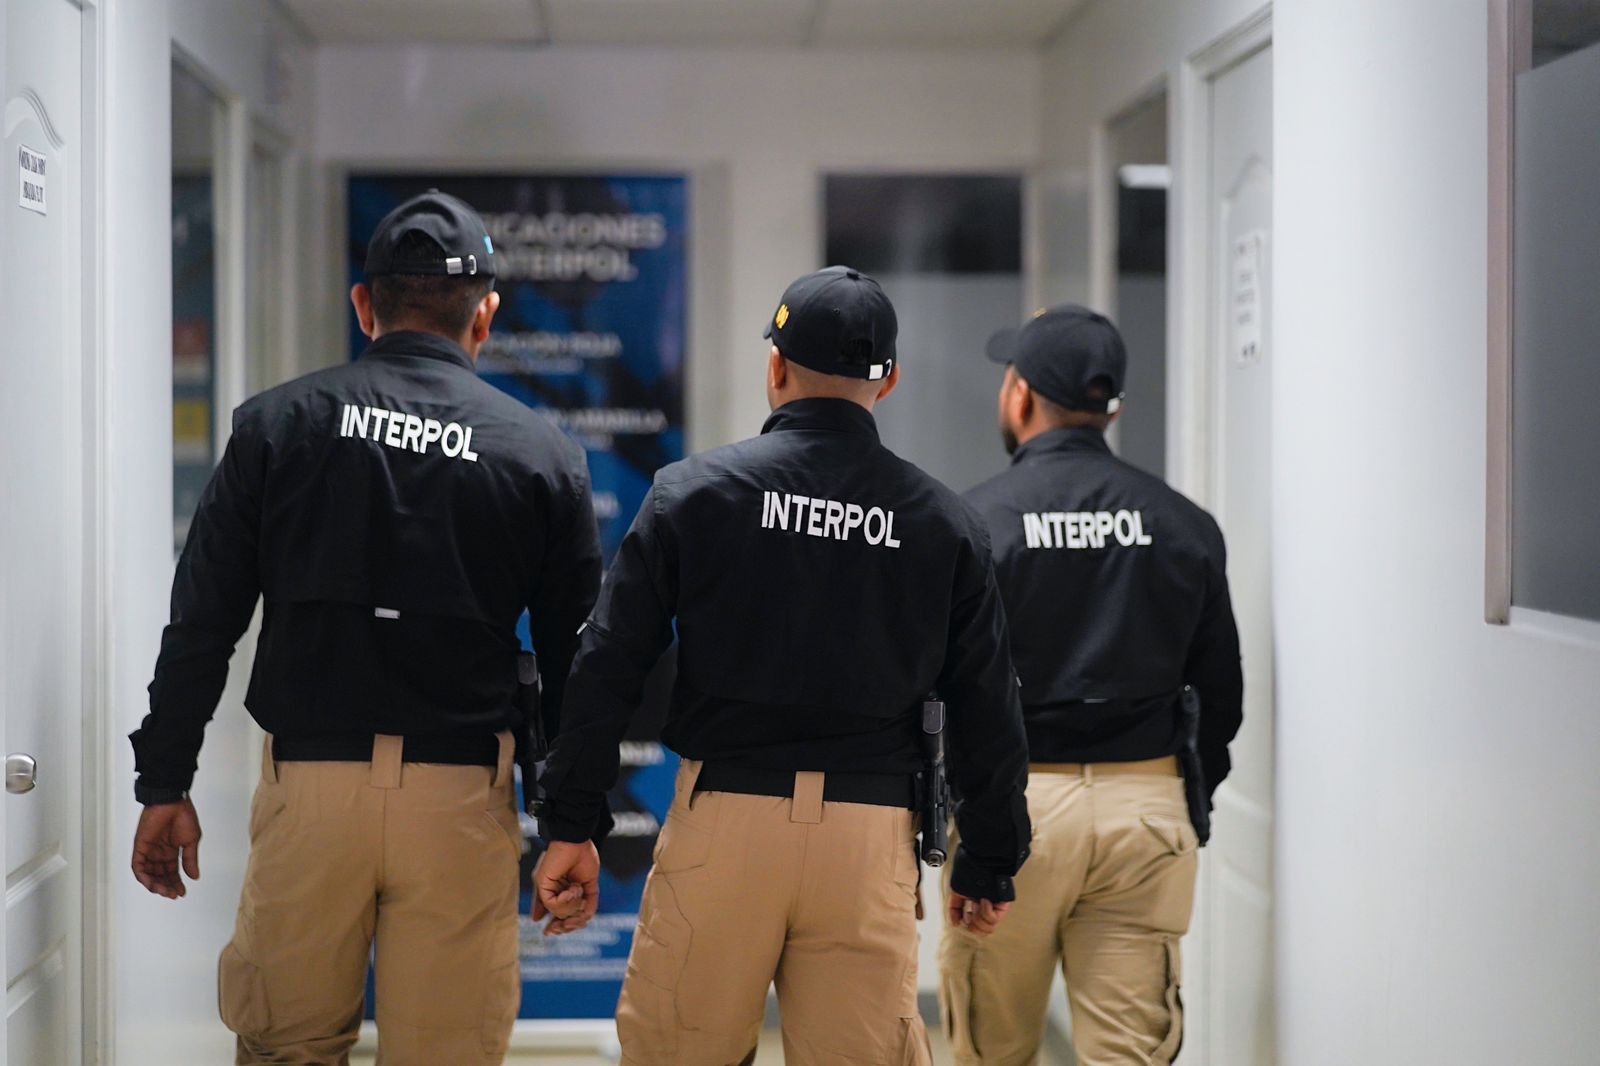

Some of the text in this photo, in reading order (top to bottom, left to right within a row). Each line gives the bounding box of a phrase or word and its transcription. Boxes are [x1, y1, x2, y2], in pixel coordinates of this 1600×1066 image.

[340, 403, 479, 462] INTERPOL
[761, 490, 901, 549] INTERPOL
[1022, 509, 1152, 549] INTERPOL
